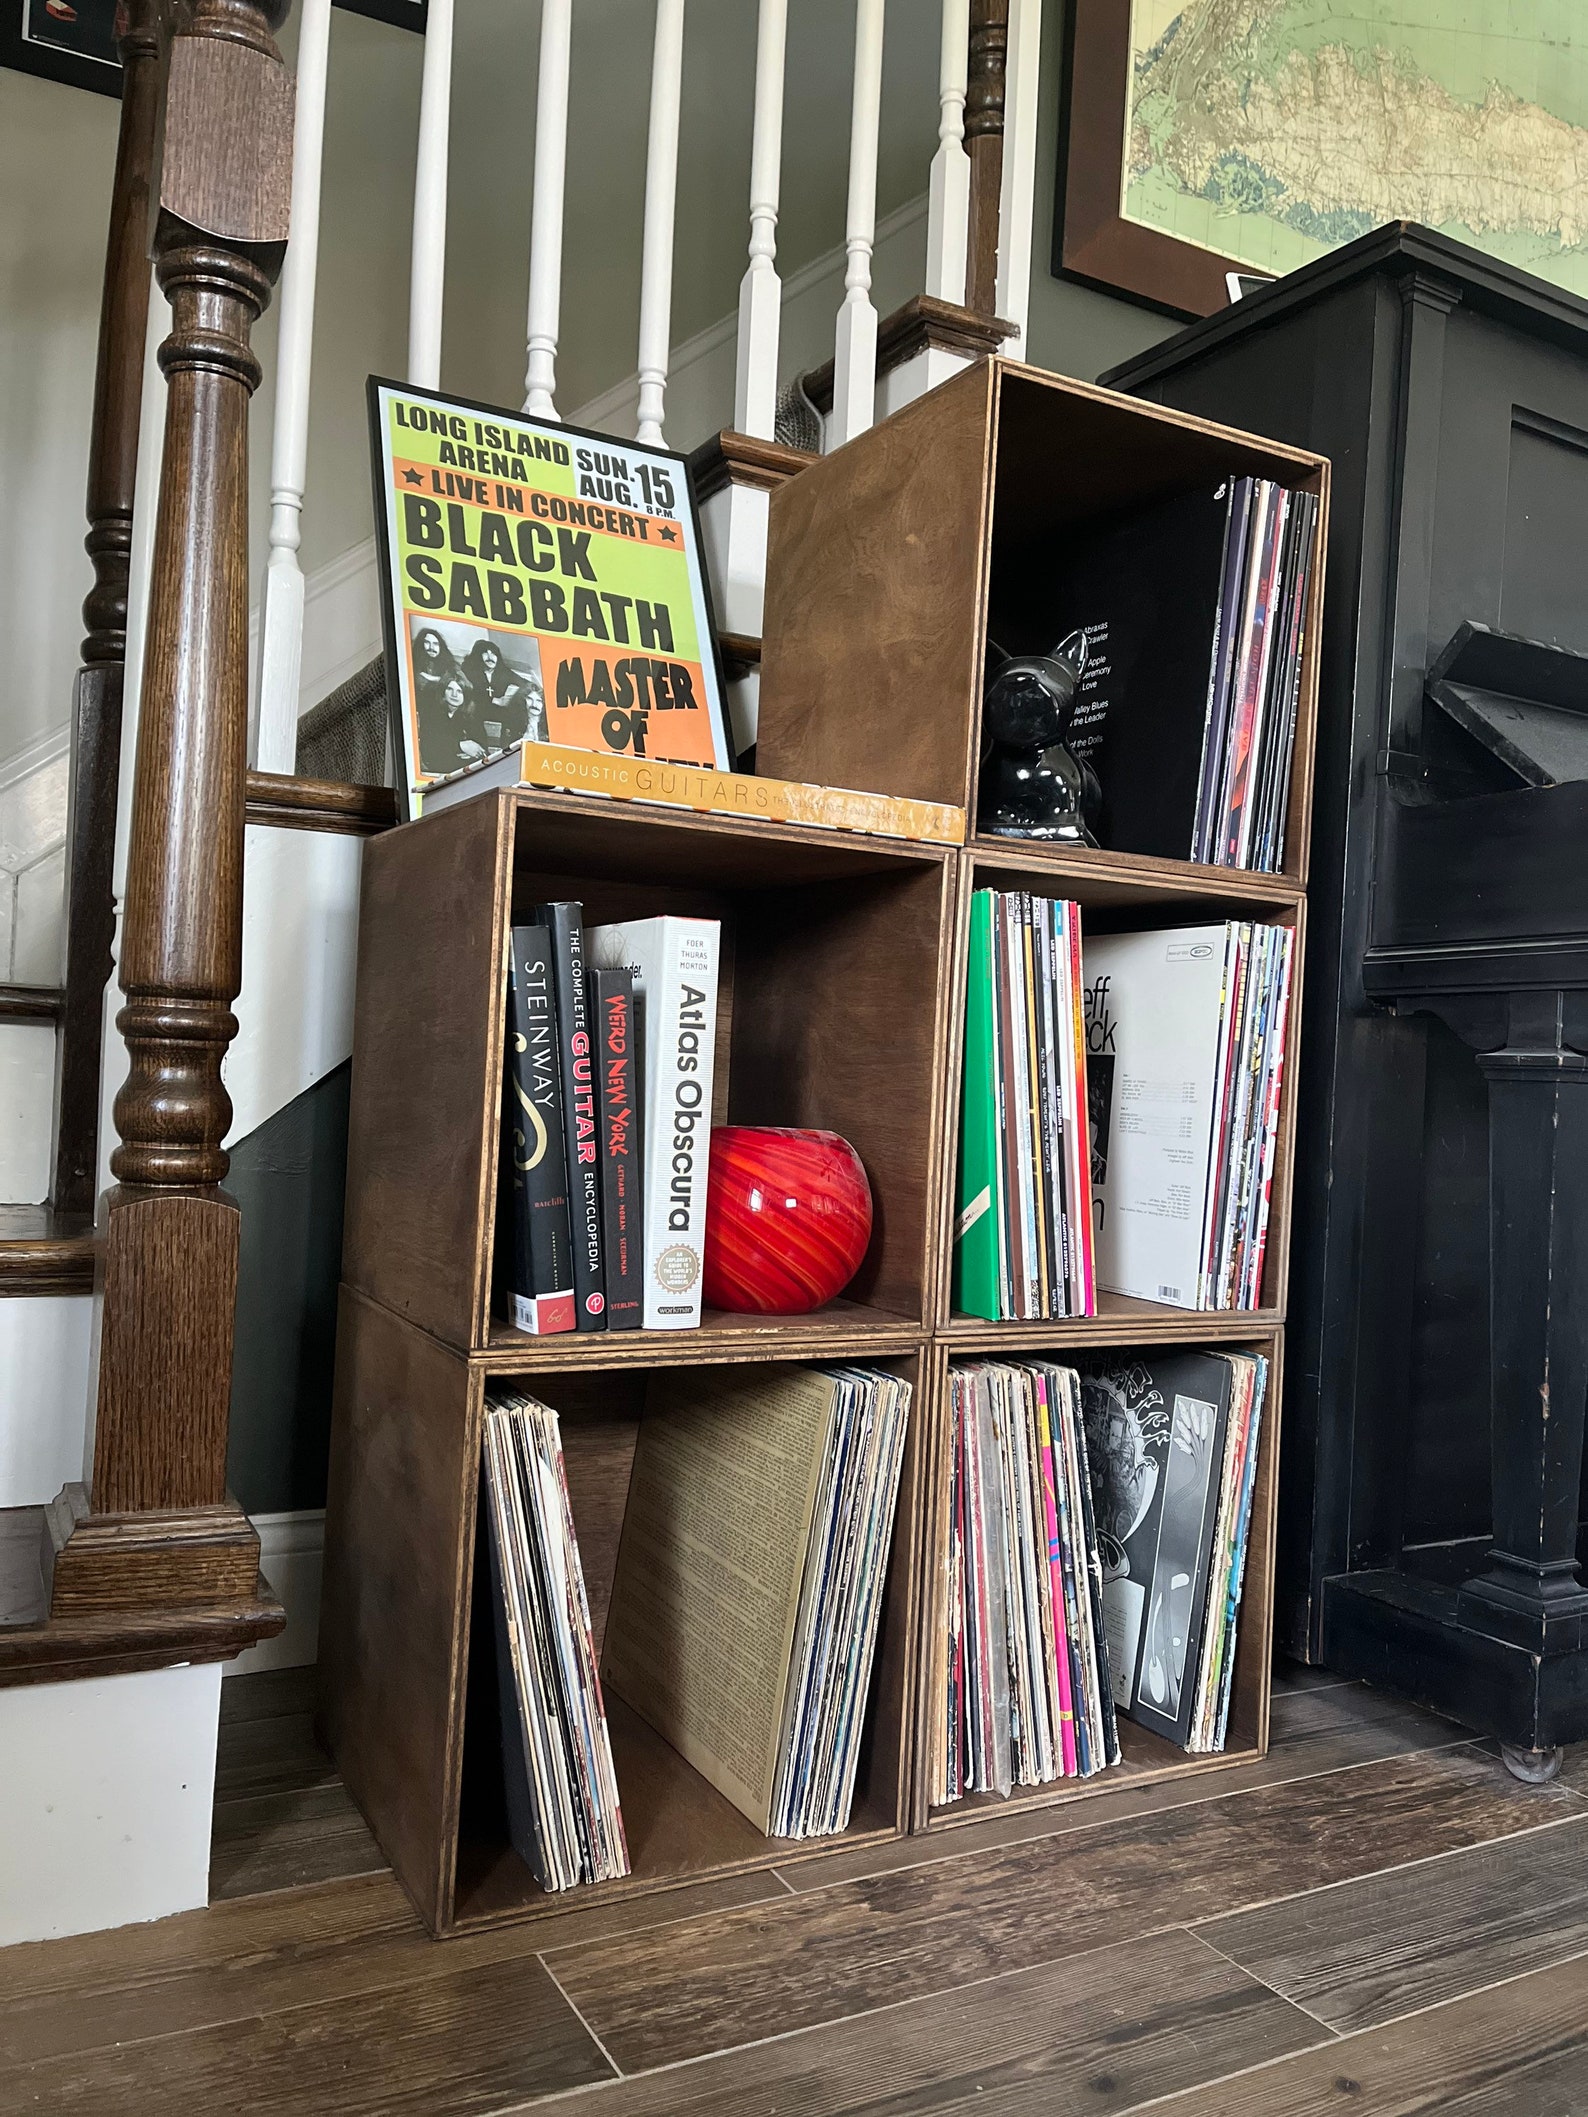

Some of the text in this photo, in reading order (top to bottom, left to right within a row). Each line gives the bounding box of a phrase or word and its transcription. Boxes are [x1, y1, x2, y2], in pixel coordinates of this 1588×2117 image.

[396, 402, 570, 466] LONG ISLAND
[440, 440, 528, 482] ARENA
[576, 448, 636, 482] SUN.
[432, 469, 649, 540] LIVE IN CONCERT
[580, 474, 638, 508] AUG.
[635, 464, 675, 509] 15
[646, 505, 676, 519] 8 P.M.
[404, 494, 597, 582] BLACK
[405, 553, 675, 652] SABBATH
[1082, 665, 1112, 680] eremony
[1087, 655, 1107, 667] Apple
[556, 657, 699, 711] MASTER
[1082, 680, 1098, 691] Love
[1084, 711, 1107, 724] Leader
[1091, 700, 1109, 711] Blues
[601, 709, 648, 754] OF
[540, 759, 629, 783] ACOUSTIC
[636, 767, 769, 809] GUITARS
[681, 950, 708, 960] THURAS
[686, 939, 704, 948] FOER
[570, 928, 585, 1028] THE COMPLETE
[680, 962, 708, 971] MORTON
[525, 961, 554, 1108] STEINWAY
[677, 983, 706, 1072] Atlas
[571, 1030, 597, 1165] GUITAR
[605, 1058, 628, 1104] NEW
[608, 1107, 632, 1157] YORK
[668, 1080, 703, 1232] Obscura
[584, 1172, 599, 1272] ENCYCLOPEDIA
[610, 1301, 640, 1311] STERLING
[658, 1306, 692, 1314] workman
